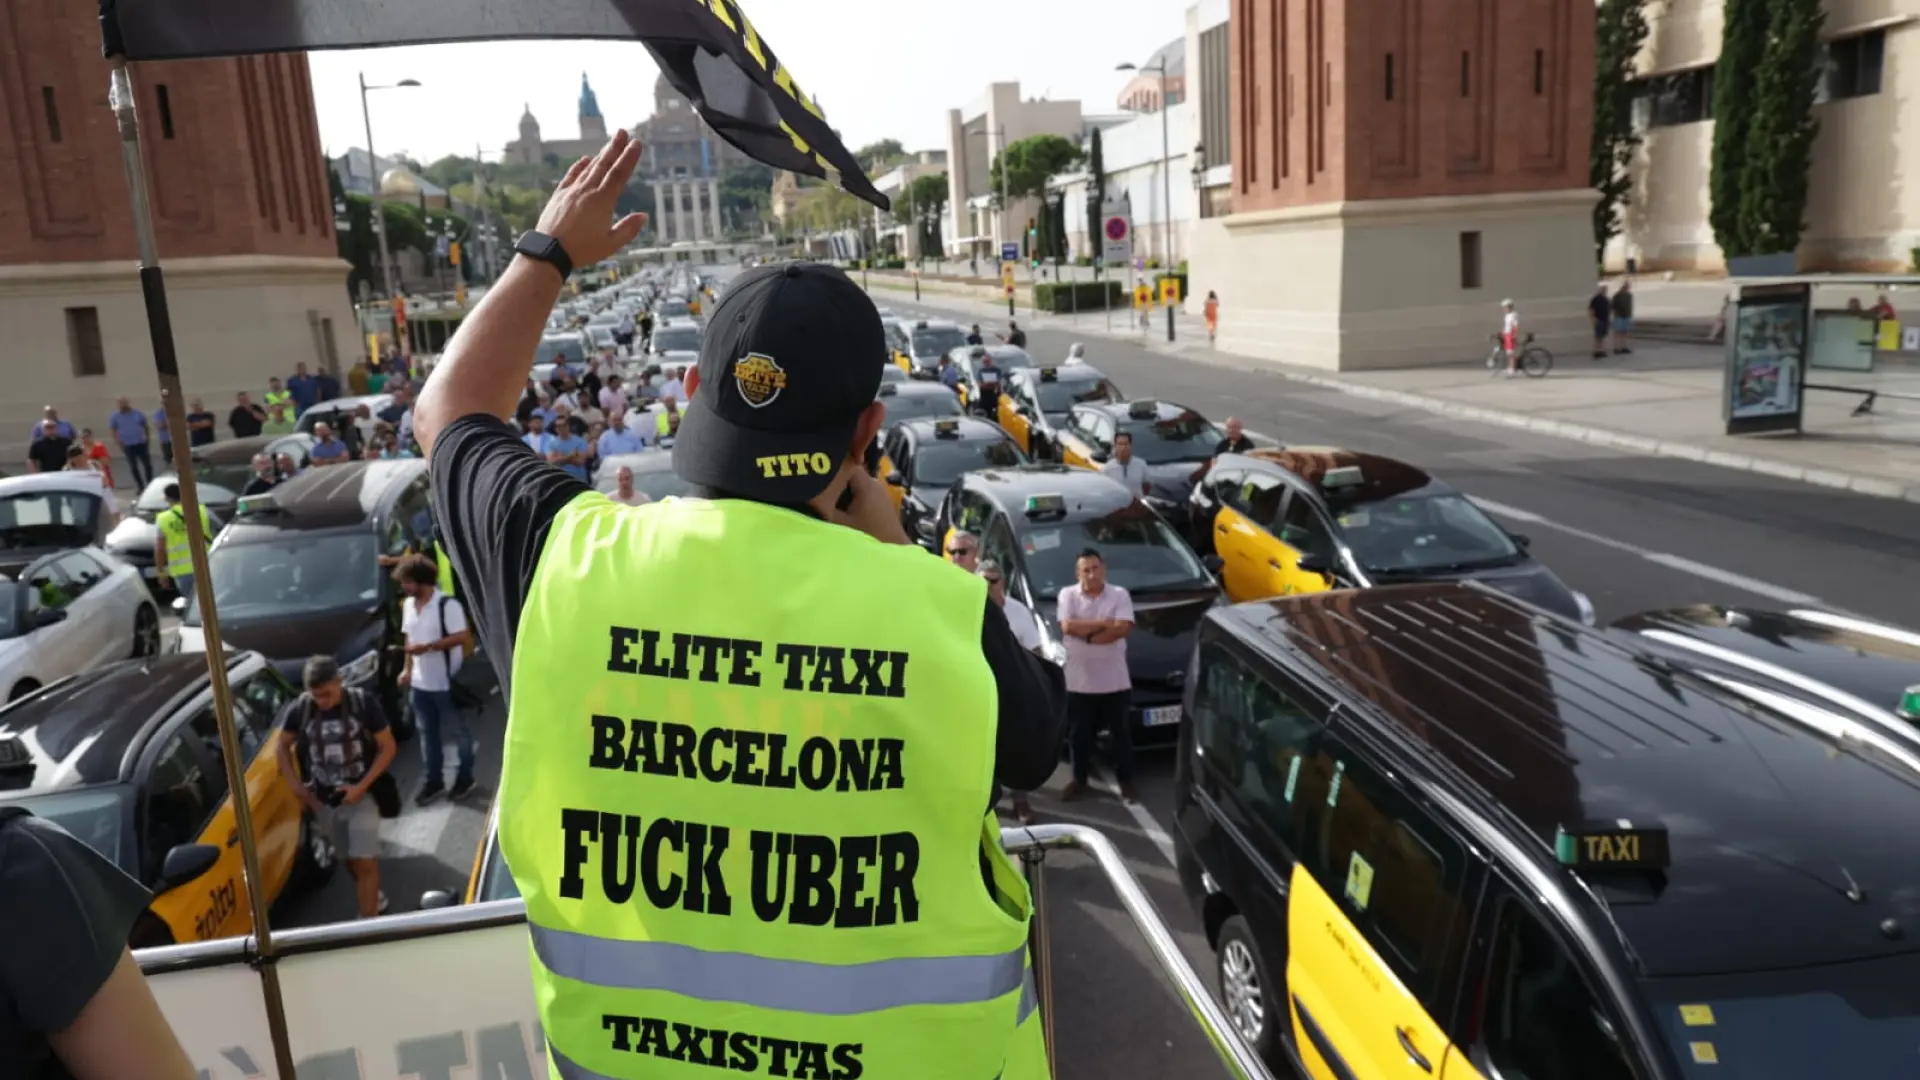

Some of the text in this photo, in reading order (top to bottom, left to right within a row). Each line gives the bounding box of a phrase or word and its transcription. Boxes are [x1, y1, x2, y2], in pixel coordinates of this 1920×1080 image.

[756, 452, 831, 478] TITO
[607, 626, 908, 697] ELITE TAXI
[590, 715, 904, 792] BARCELONA
[560, 809, 919, 928] FUCK UBER
[1584, 836, 1640, 861] TAXI
[602, 1015, 863, 1080] TAXISTAS
